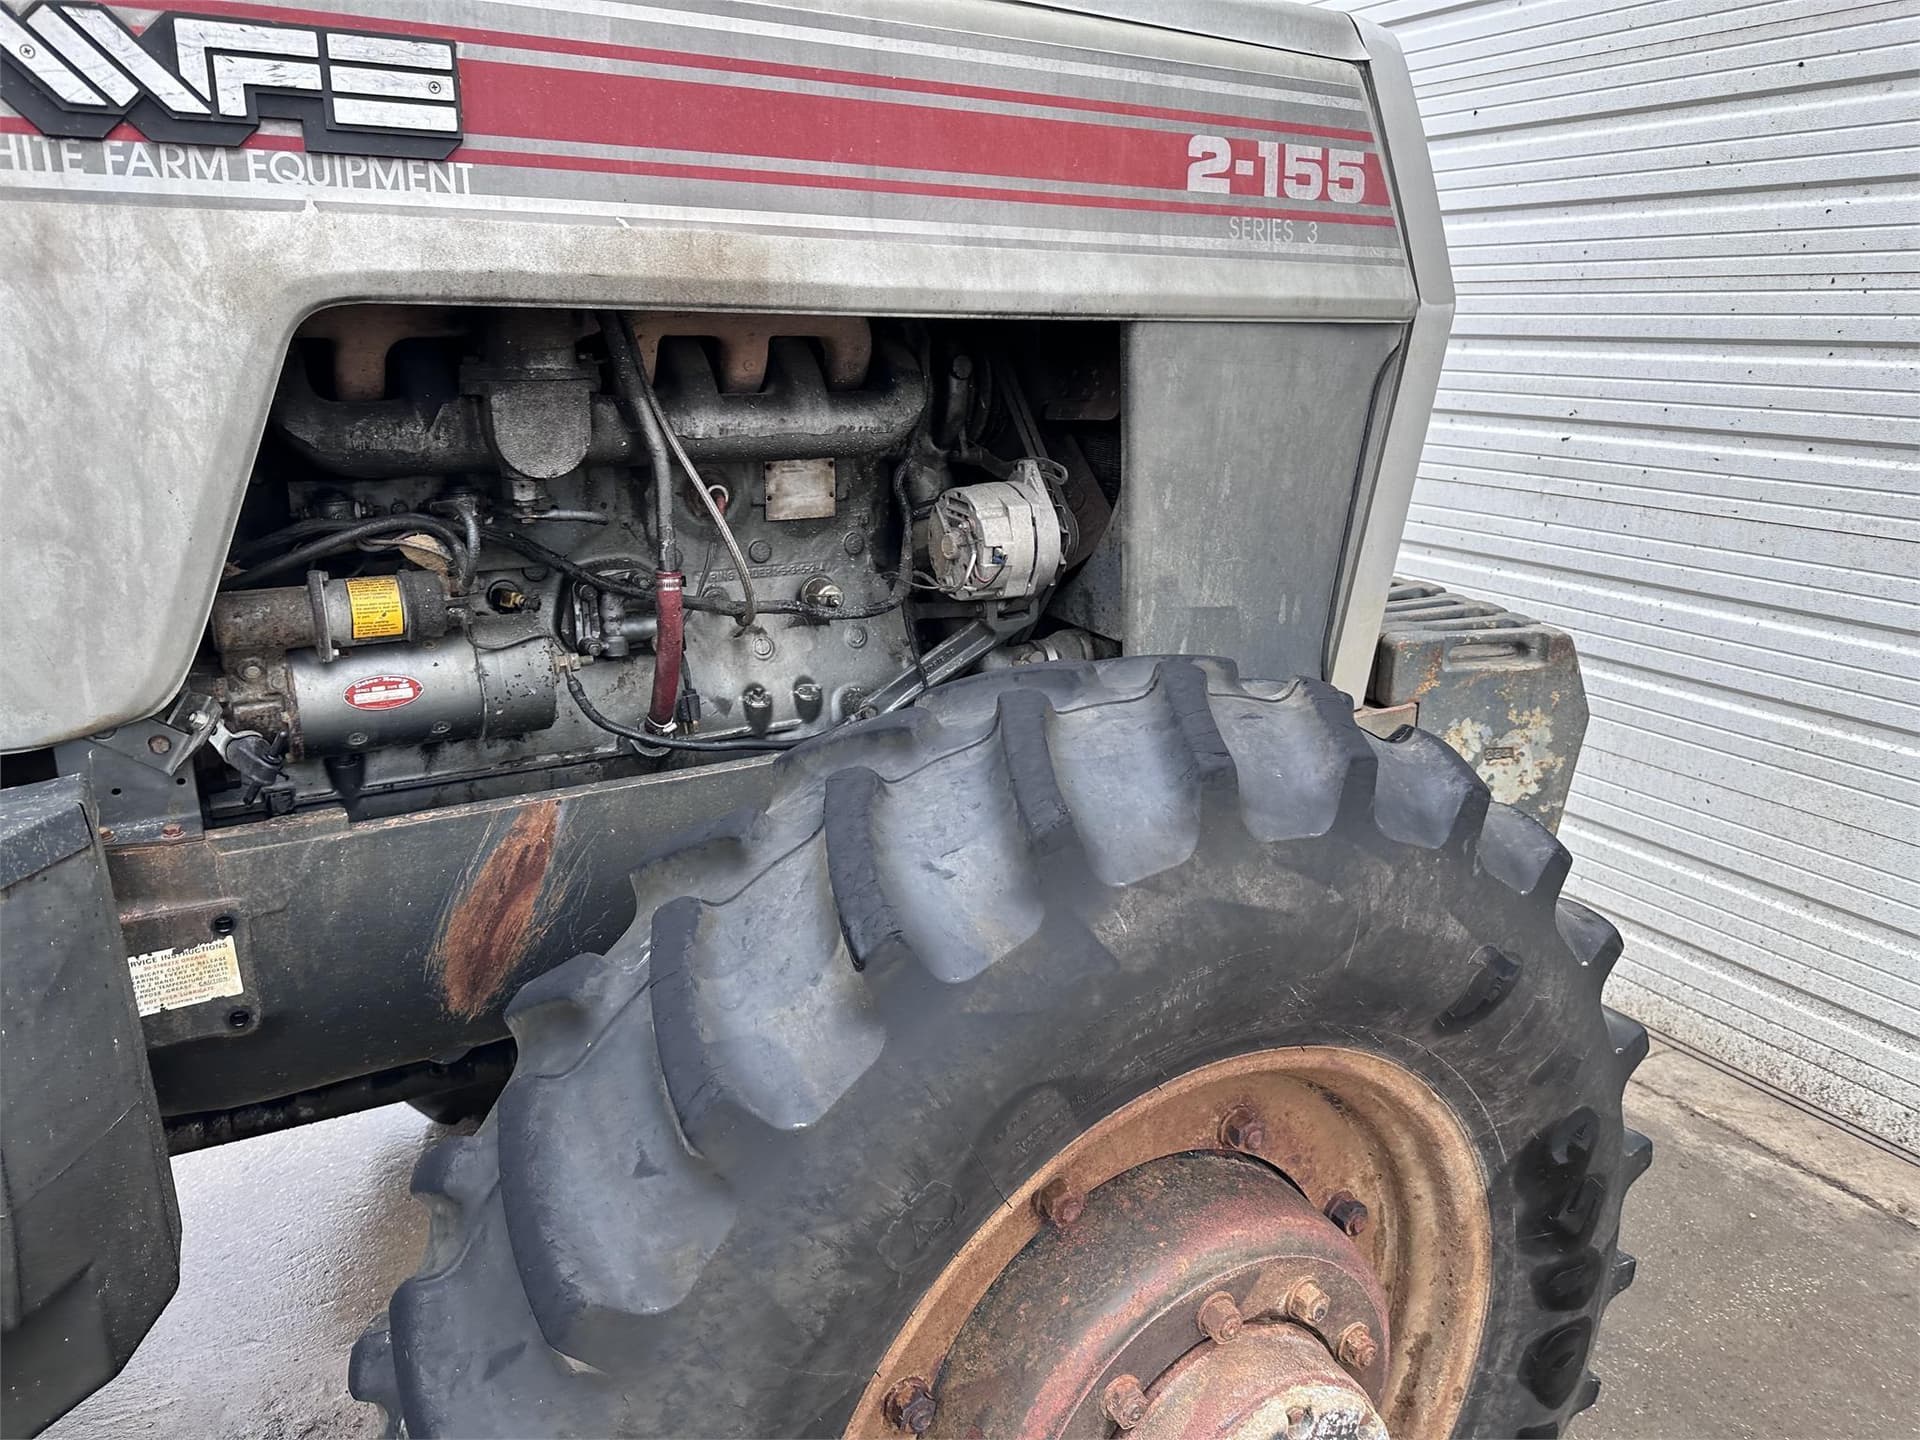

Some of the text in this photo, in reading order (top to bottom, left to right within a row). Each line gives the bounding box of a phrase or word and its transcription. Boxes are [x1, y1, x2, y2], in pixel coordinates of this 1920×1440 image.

[102, 140, 229, 182] FARM
[246, 149, 473, 194] EQUIPMENT
[1187, 134, 1366, 203] 2-155
[1228, 217, 1319, 244] SERIES 3
